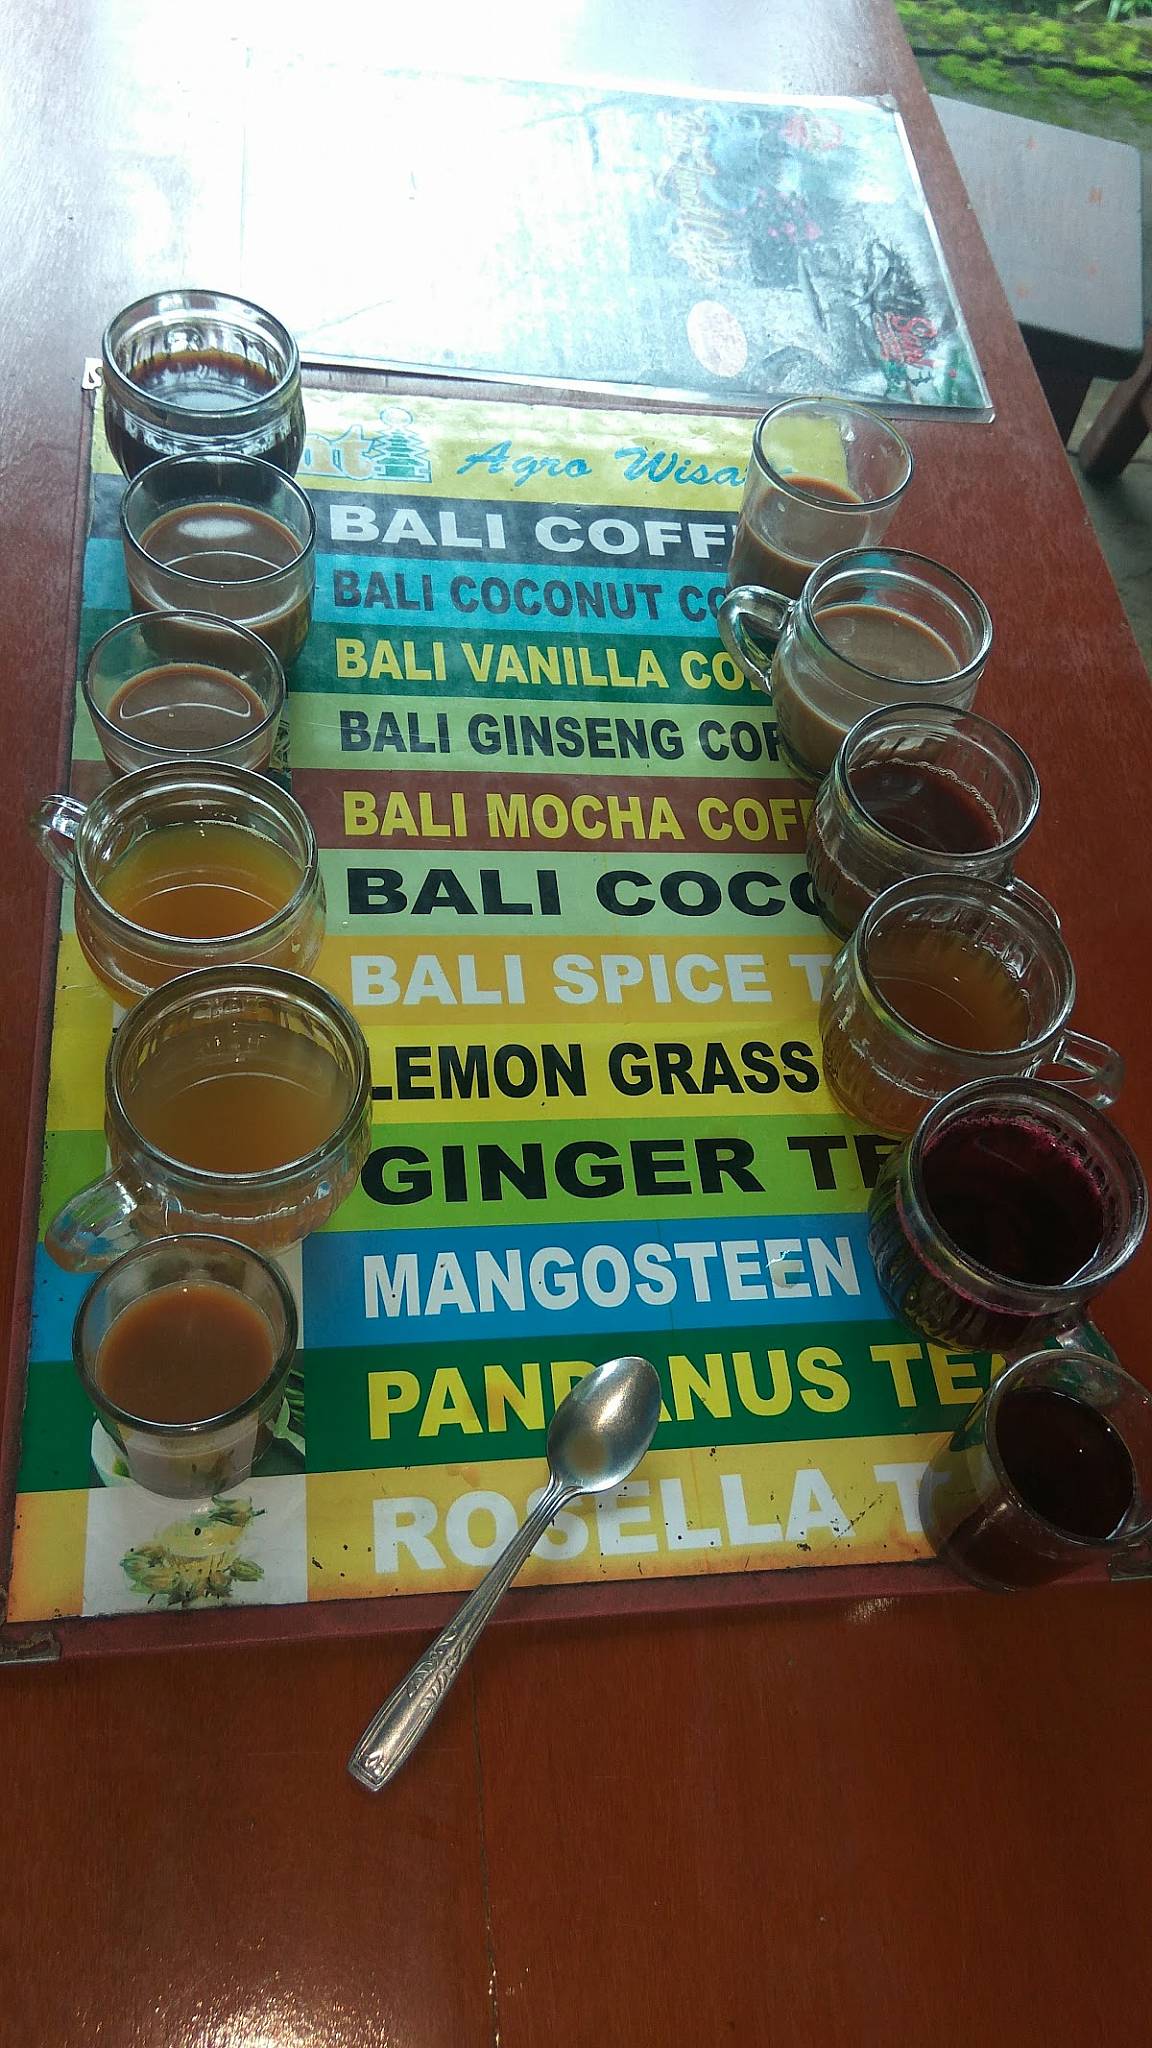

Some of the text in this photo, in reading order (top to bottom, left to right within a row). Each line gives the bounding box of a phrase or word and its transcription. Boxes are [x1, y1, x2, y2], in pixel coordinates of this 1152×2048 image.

[457, 439, 748, 488] Agro Wisa
[329, 504, 738, 559] BALI COFF
[332, 569, 434, 612] BALI
[450, 574, 663, 621] COCONUT
[334, 637, 763, 692] BALI VANILLA CO
[338, 709, 451, 753] BALI
[467, 713, 685, 761] GINSENG
[342, 790, 469, 837] BALI
[486, 793, 686, 841] MOCHA
[346, 867, 562, 916] BALI
[349, 954, 527, 1006] BALI
[553, 953, 773, 1004] SPICE
[608, 1041, 821, 1098] GRASS
[360, 1137, 766, 1206] GINGER
[363, 1236, 861, 1319] MANGOSTEEN
[367, 1343, 1007, 1440] PANNUS TE
